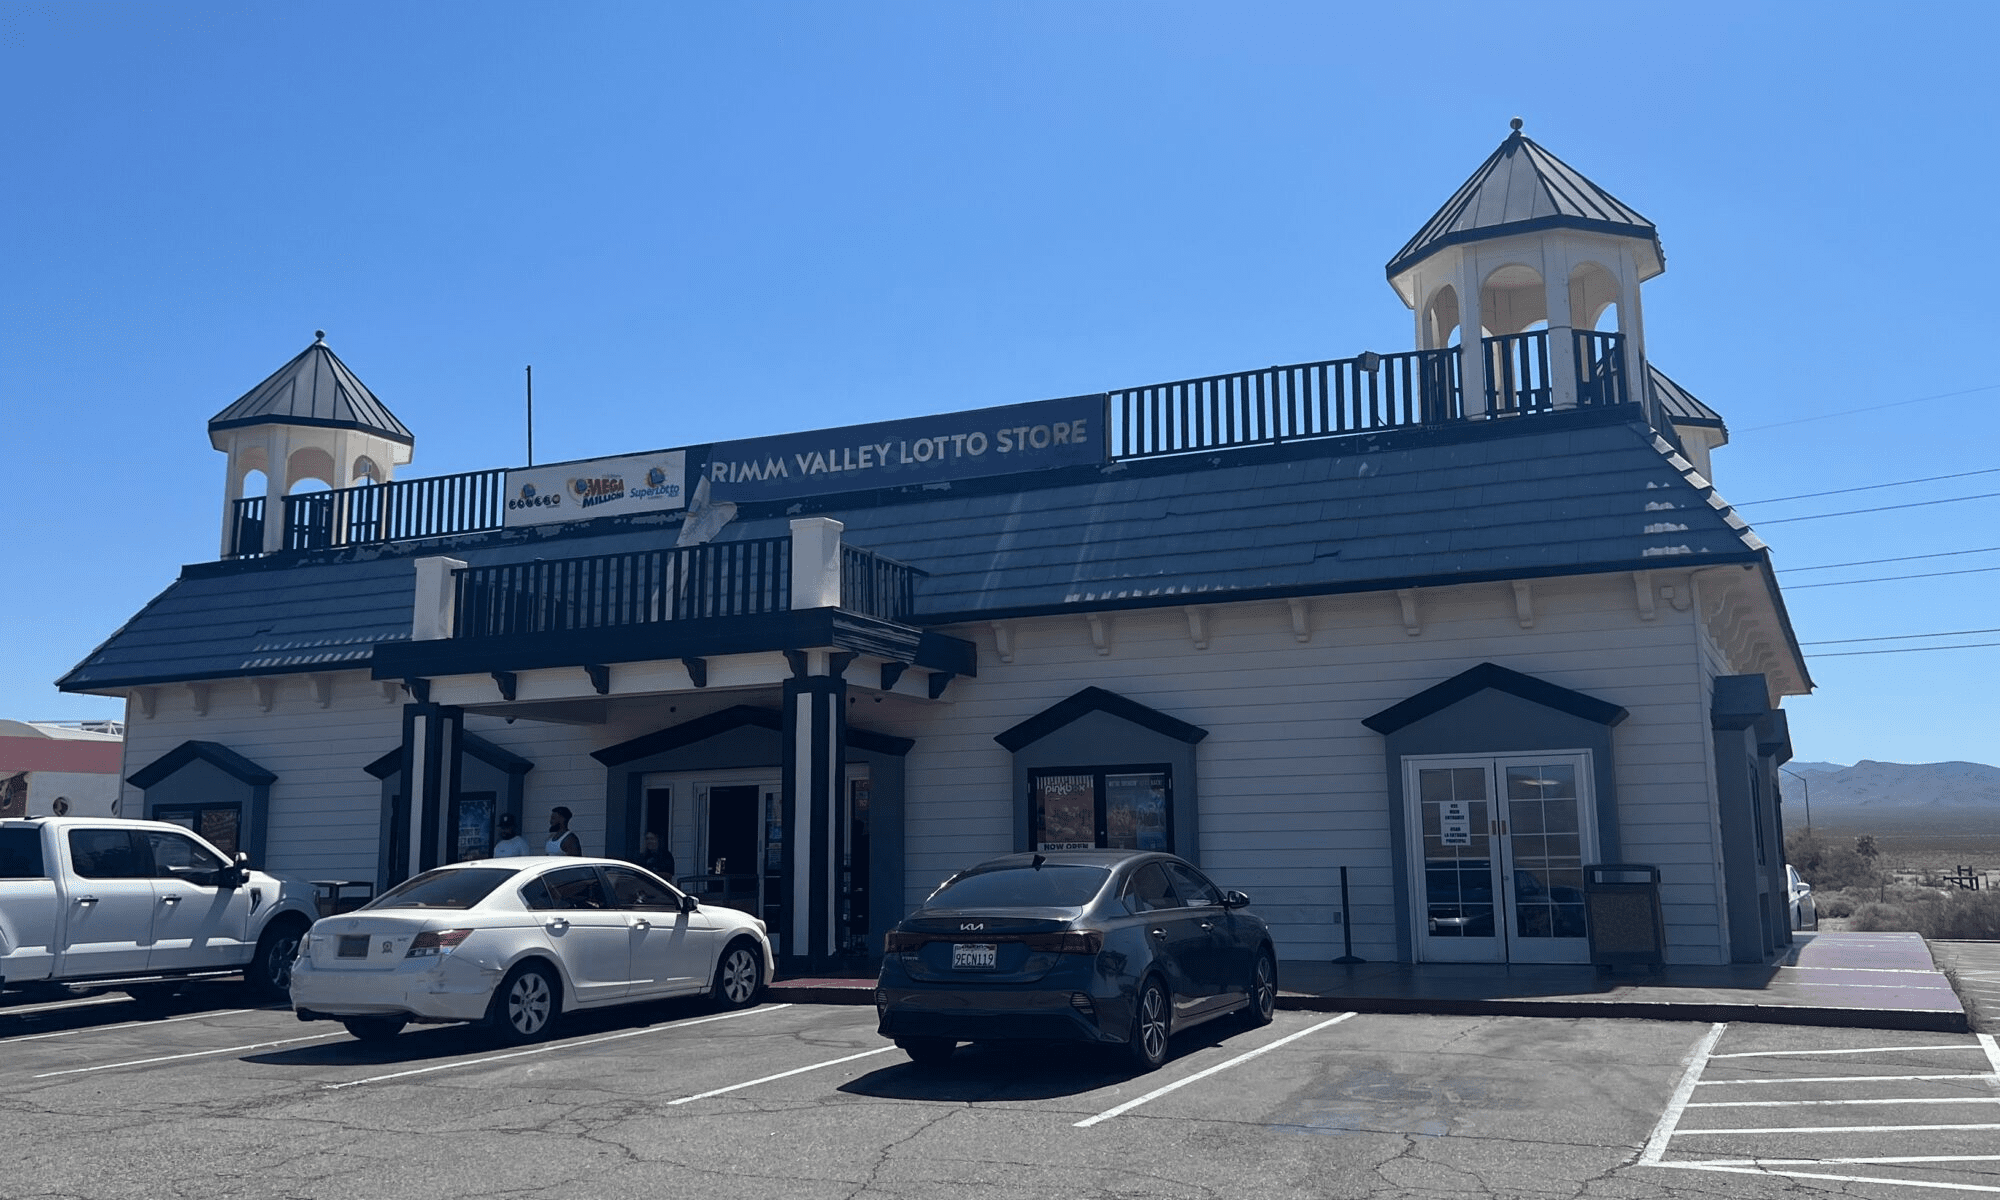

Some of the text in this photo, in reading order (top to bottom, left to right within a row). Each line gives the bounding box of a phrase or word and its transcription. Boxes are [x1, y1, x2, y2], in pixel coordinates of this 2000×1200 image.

[701, 418, 1088, 483] RIMM VALLEY LOTTO STORE
[588, 478, 624, 496] MEGA
[960, 923, 984, 931] KIA
[955, 953, 994, 966] 9ECN119
